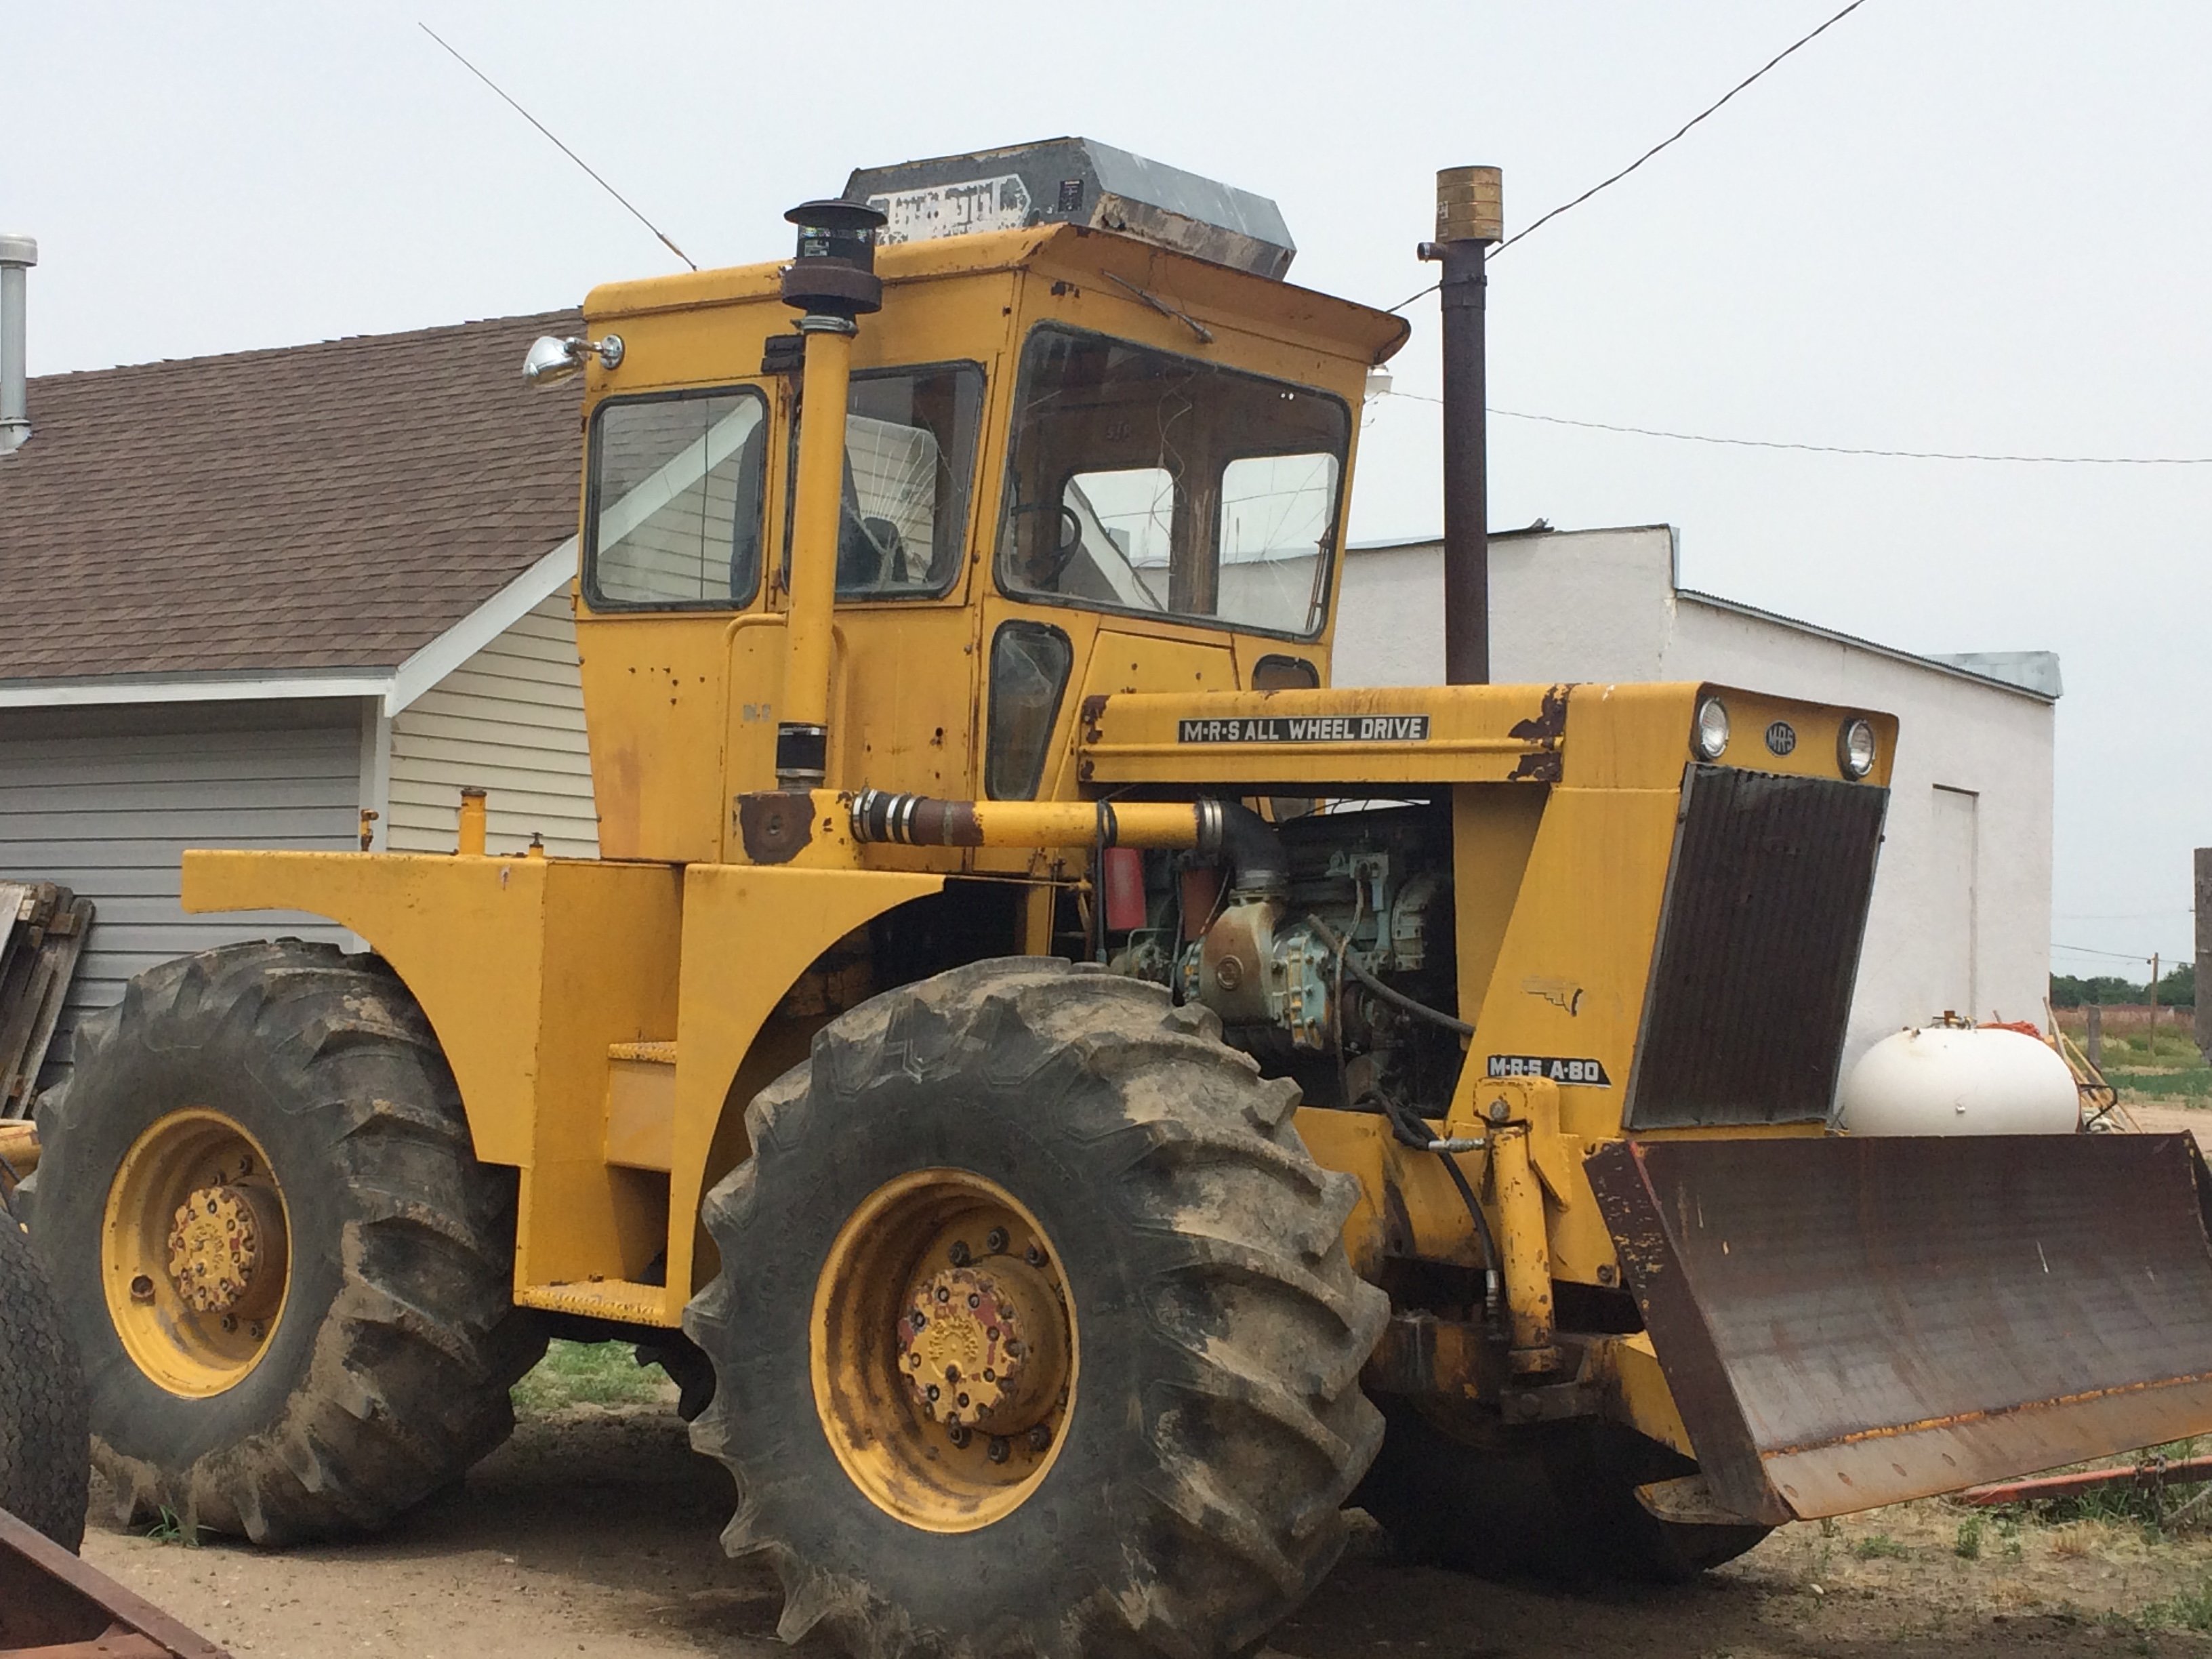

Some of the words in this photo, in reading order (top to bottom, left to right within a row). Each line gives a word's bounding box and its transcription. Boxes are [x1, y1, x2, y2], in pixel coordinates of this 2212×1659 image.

[1244, 720, 1280, 741] ALL
[1288, 718, 1355, 739] WHEEL
[1359, 717, 1422, 739] DRIVE
